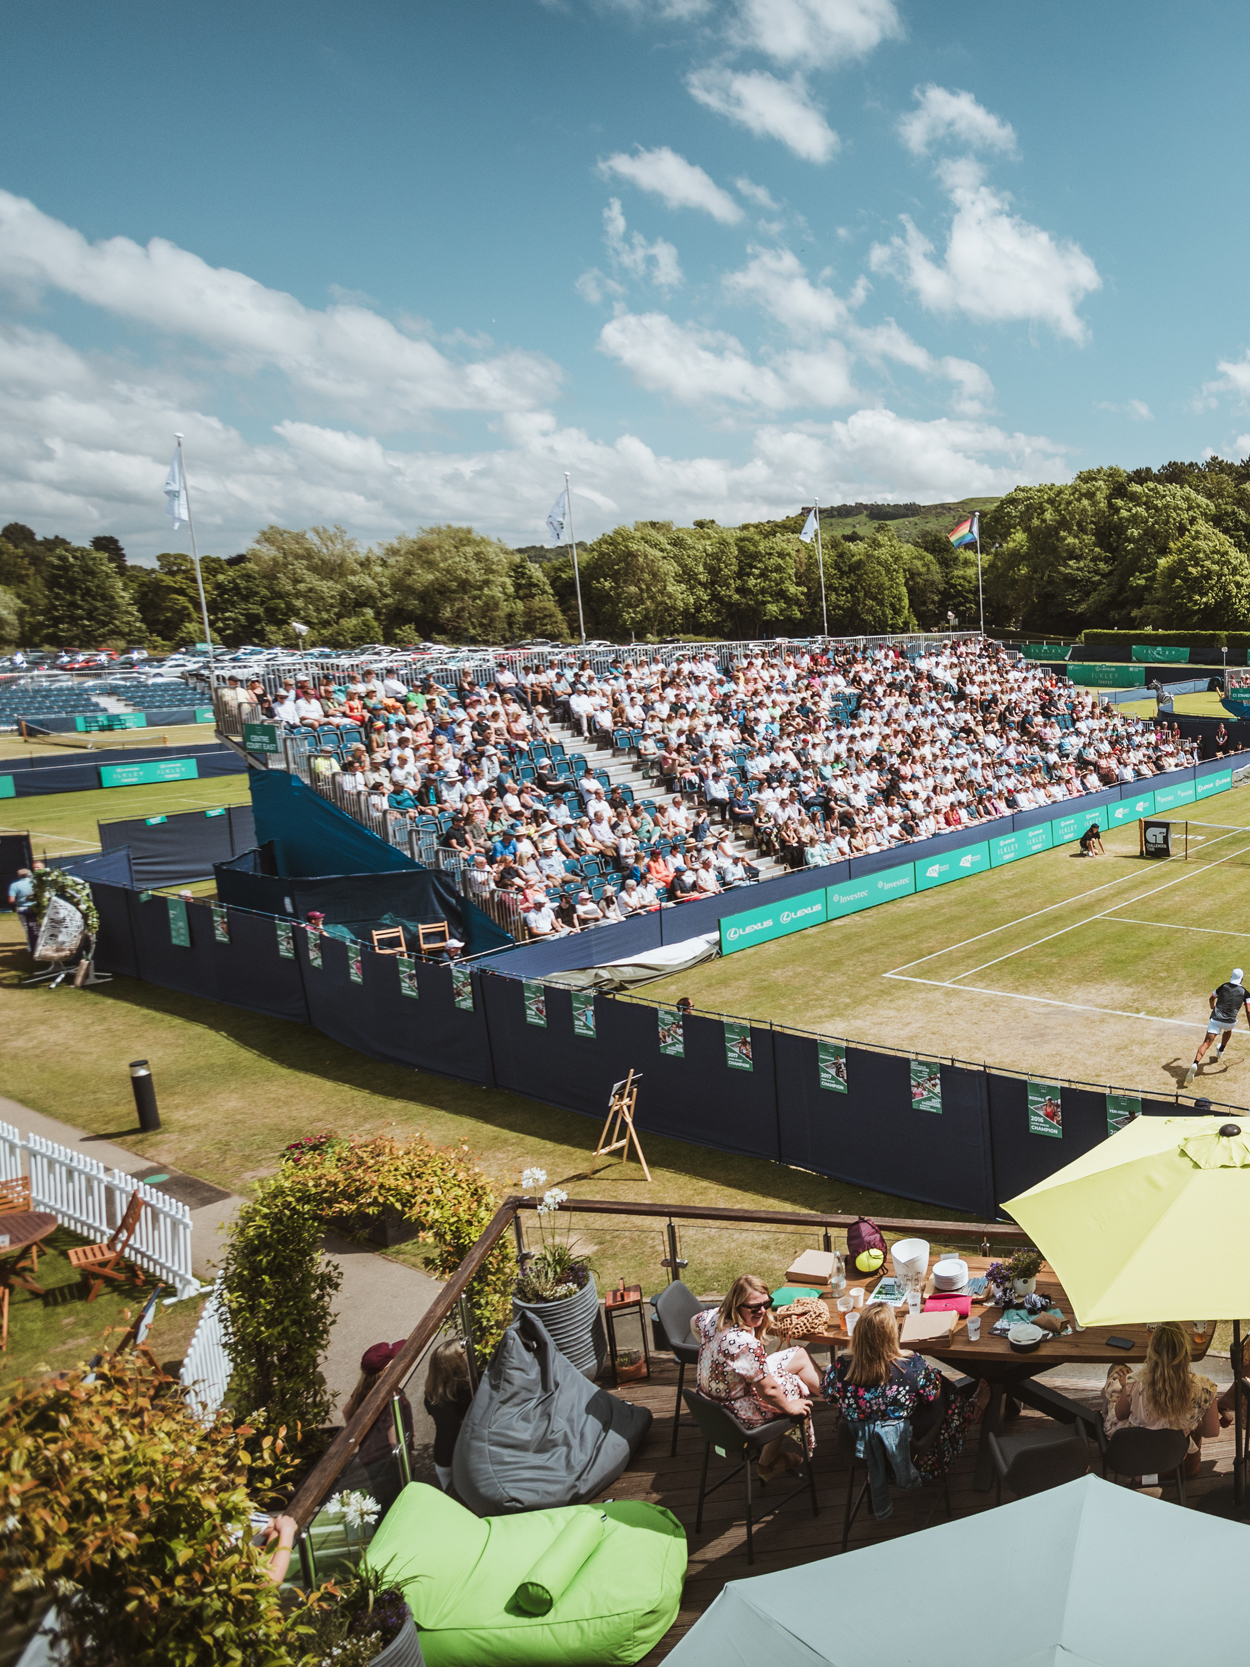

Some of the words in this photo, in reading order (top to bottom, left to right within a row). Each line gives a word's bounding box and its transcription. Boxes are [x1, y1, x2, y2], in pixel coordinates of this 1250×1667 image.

[1026, 834, 1046, 846] ILKLEY
[998, 843, 1019, 855] ILKLEY
[884, 877, 910, 890] Investec
[840, 890, 869, 904] Investec
[1031, 1115, 1044, 1123] 2016
[1031, 1125, 1058, 1135] CHAMPION
